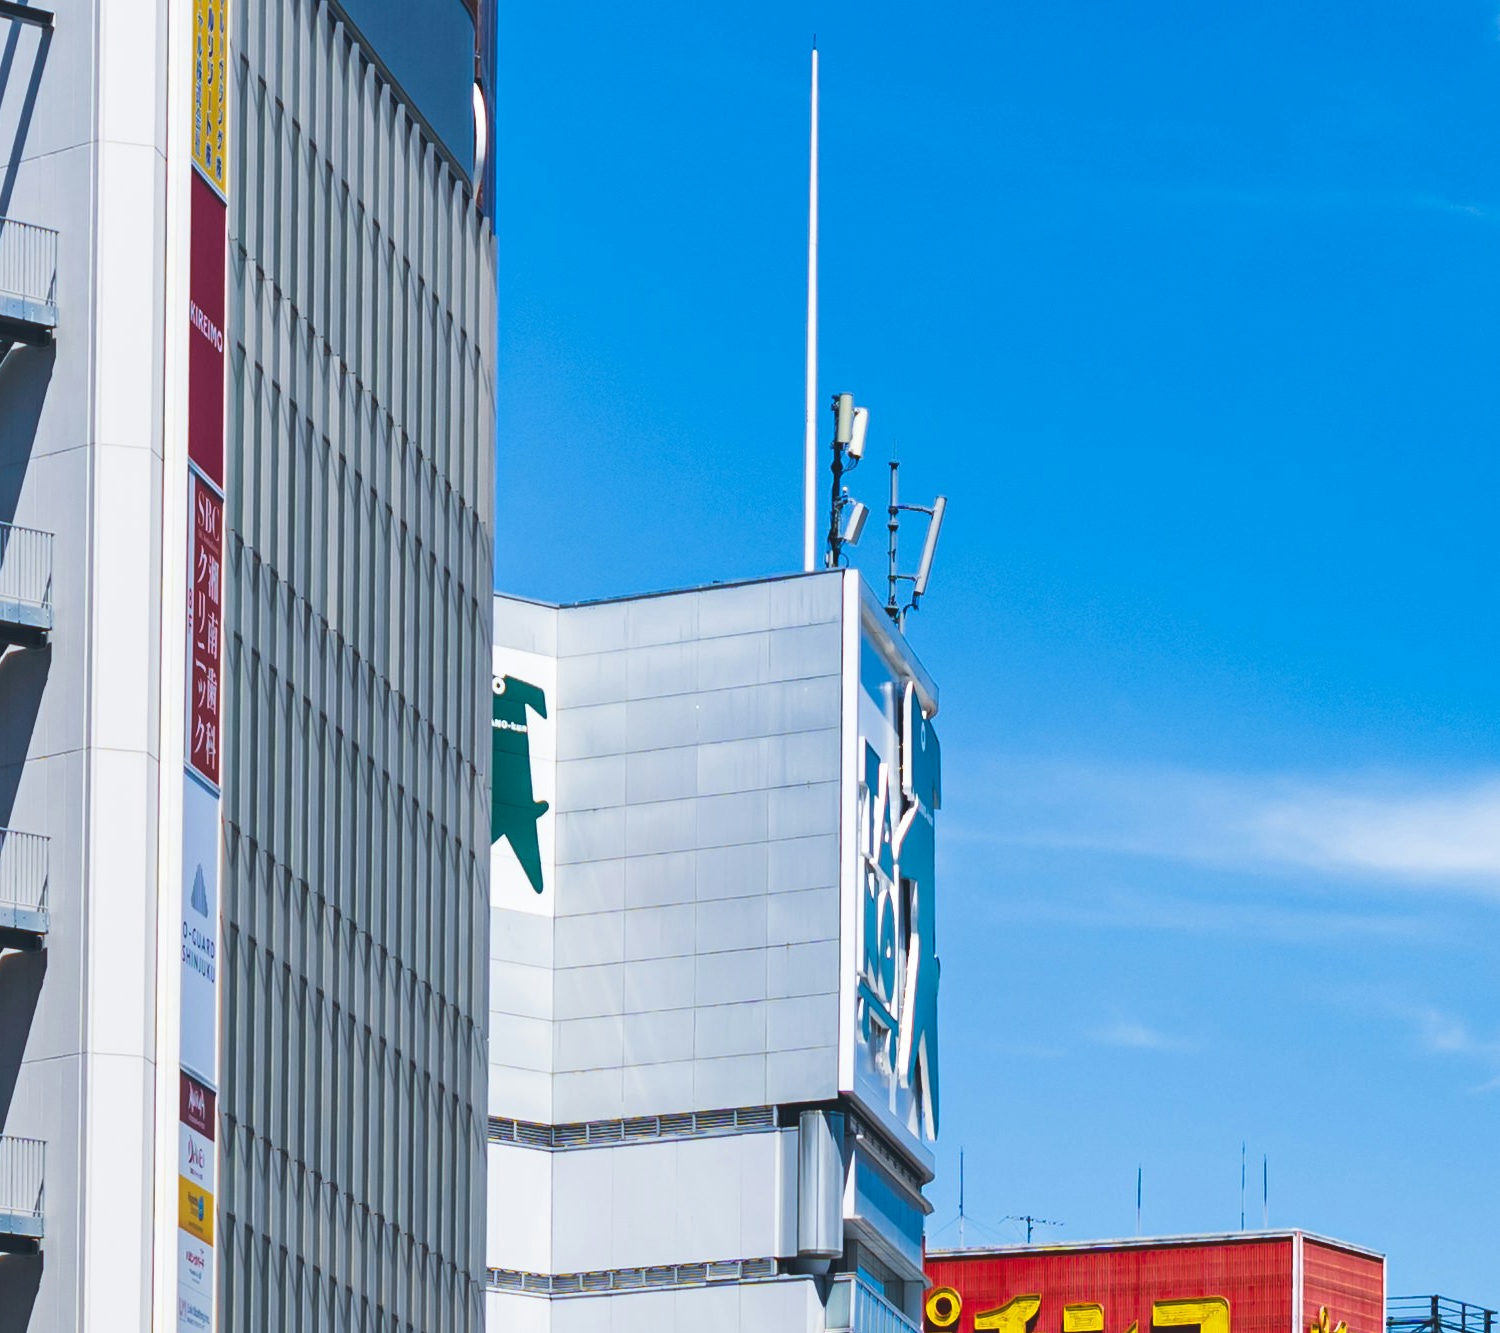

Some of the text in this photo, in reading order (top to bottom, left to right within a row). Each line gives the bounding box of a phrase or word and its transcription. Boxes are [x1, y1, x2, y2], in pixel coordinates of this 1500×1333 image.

[191, 299, 223, 353] KIREIMO
[198, 490, 220, 542] SBC
[194, 545, 207, 753] クリニック
[205, 555, 219, 770] 湘南歯科
[181, 944, 215, 983] SHINJUKU
[182, 921, 215, 959] O-GUARD
